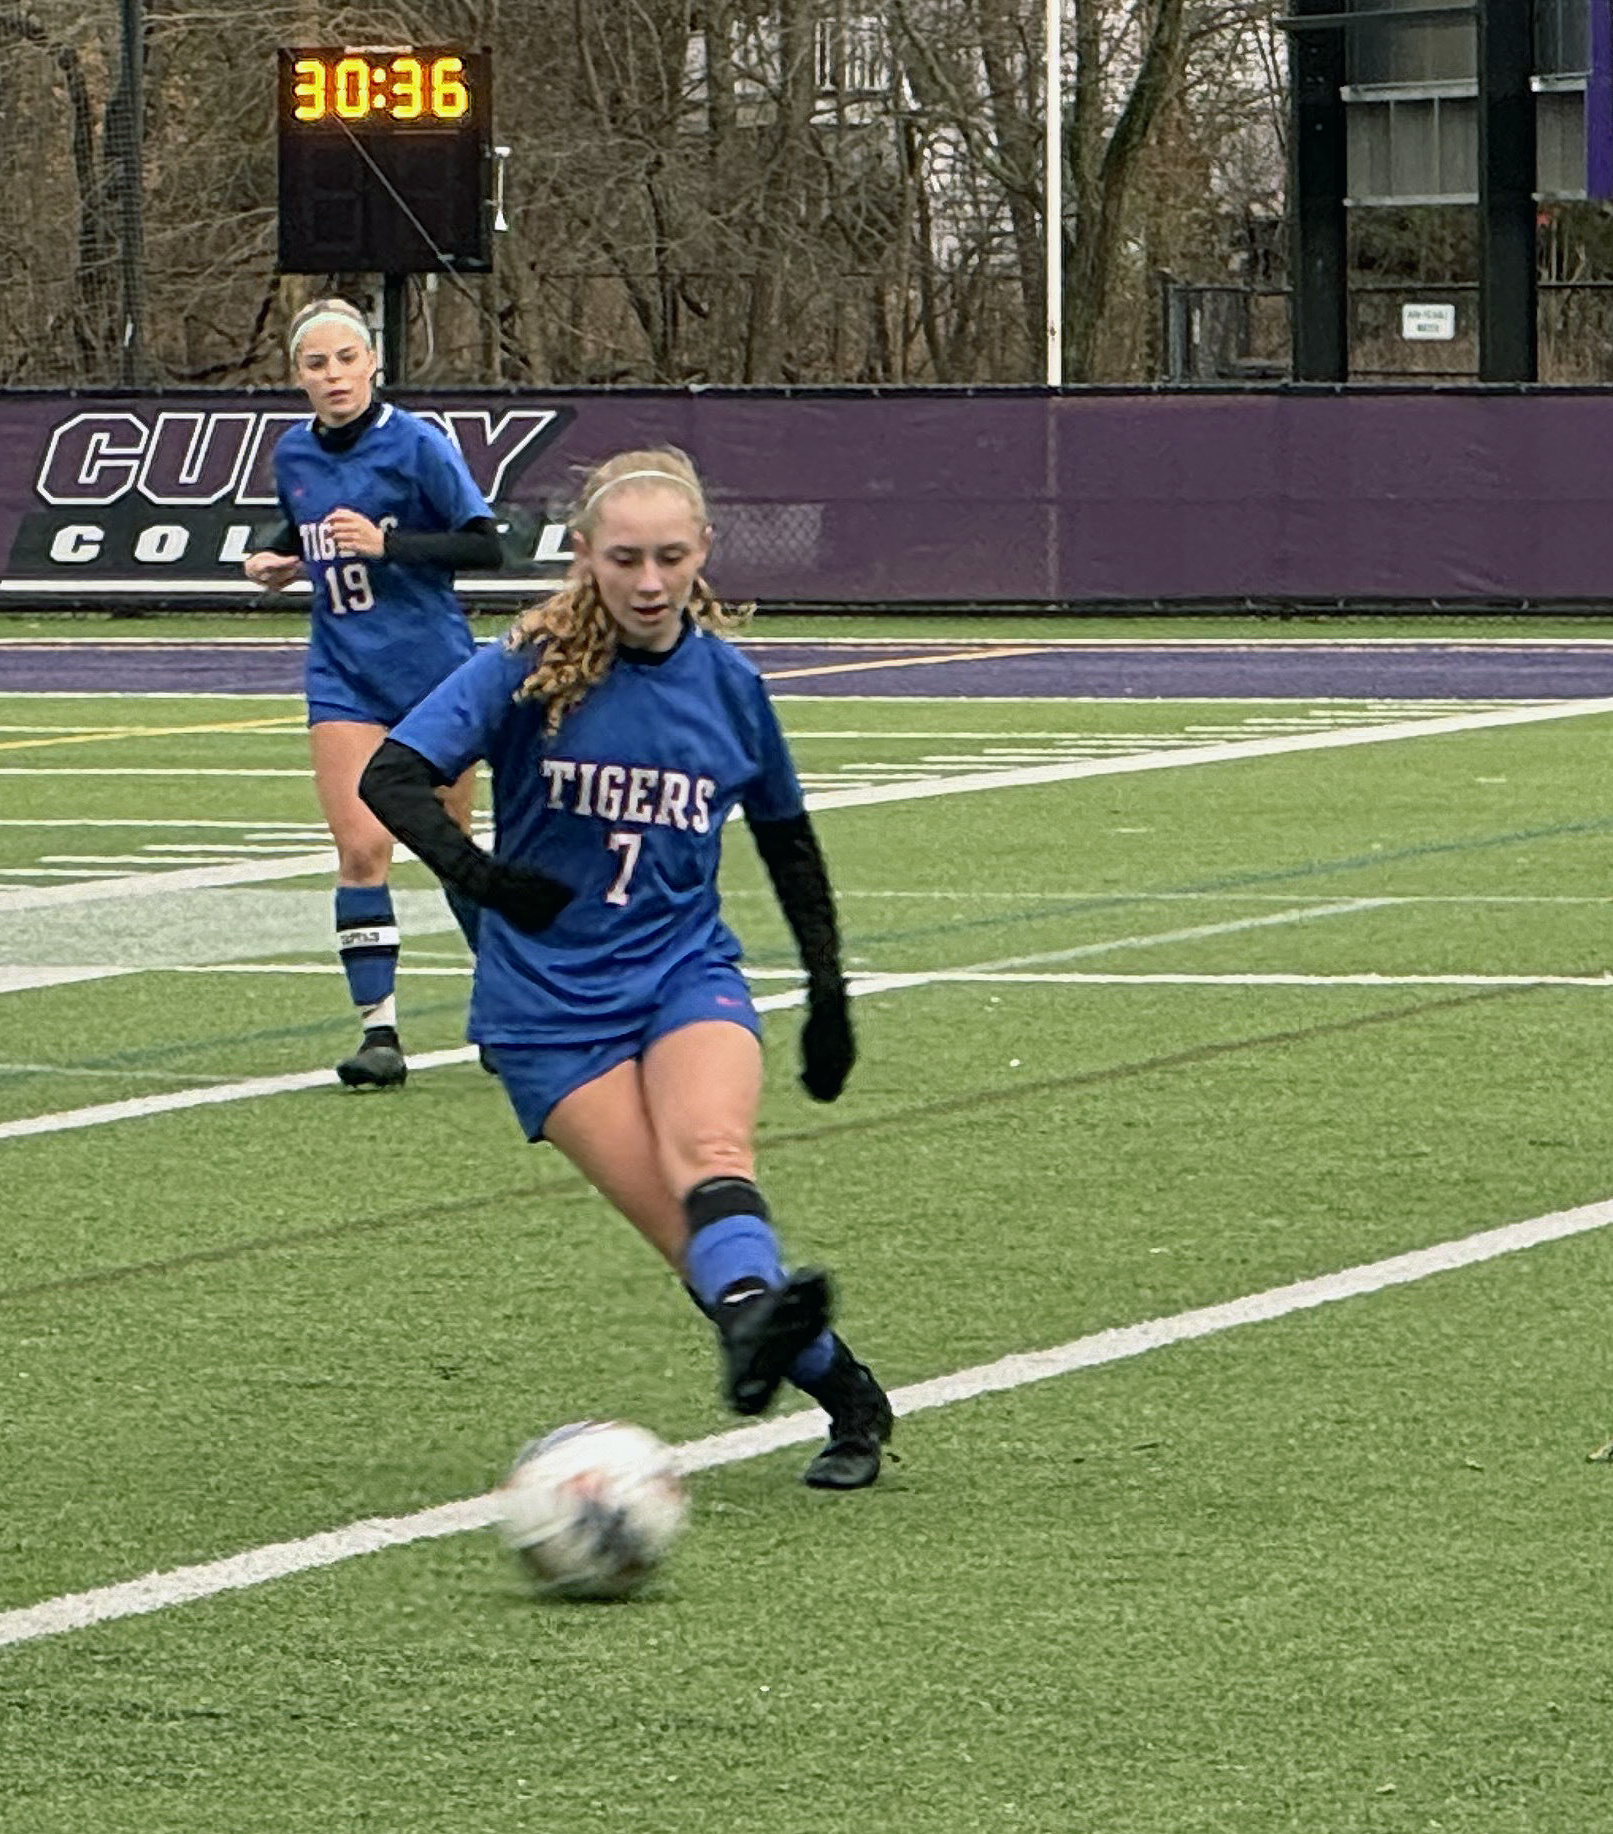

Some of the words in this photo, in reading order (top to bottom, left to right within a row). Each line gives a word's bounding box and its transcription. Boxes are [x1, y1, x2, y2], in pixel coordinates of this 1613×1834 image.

[294, 57, 469, 119] 30:36
[36, 411, 558, 506] CUY
[299, 515, 399, 561] TIG
[325, 563, 375, 615] 19
[540, 759, 717, 834] TIGERS
[606, 833, 643, 906] 7
